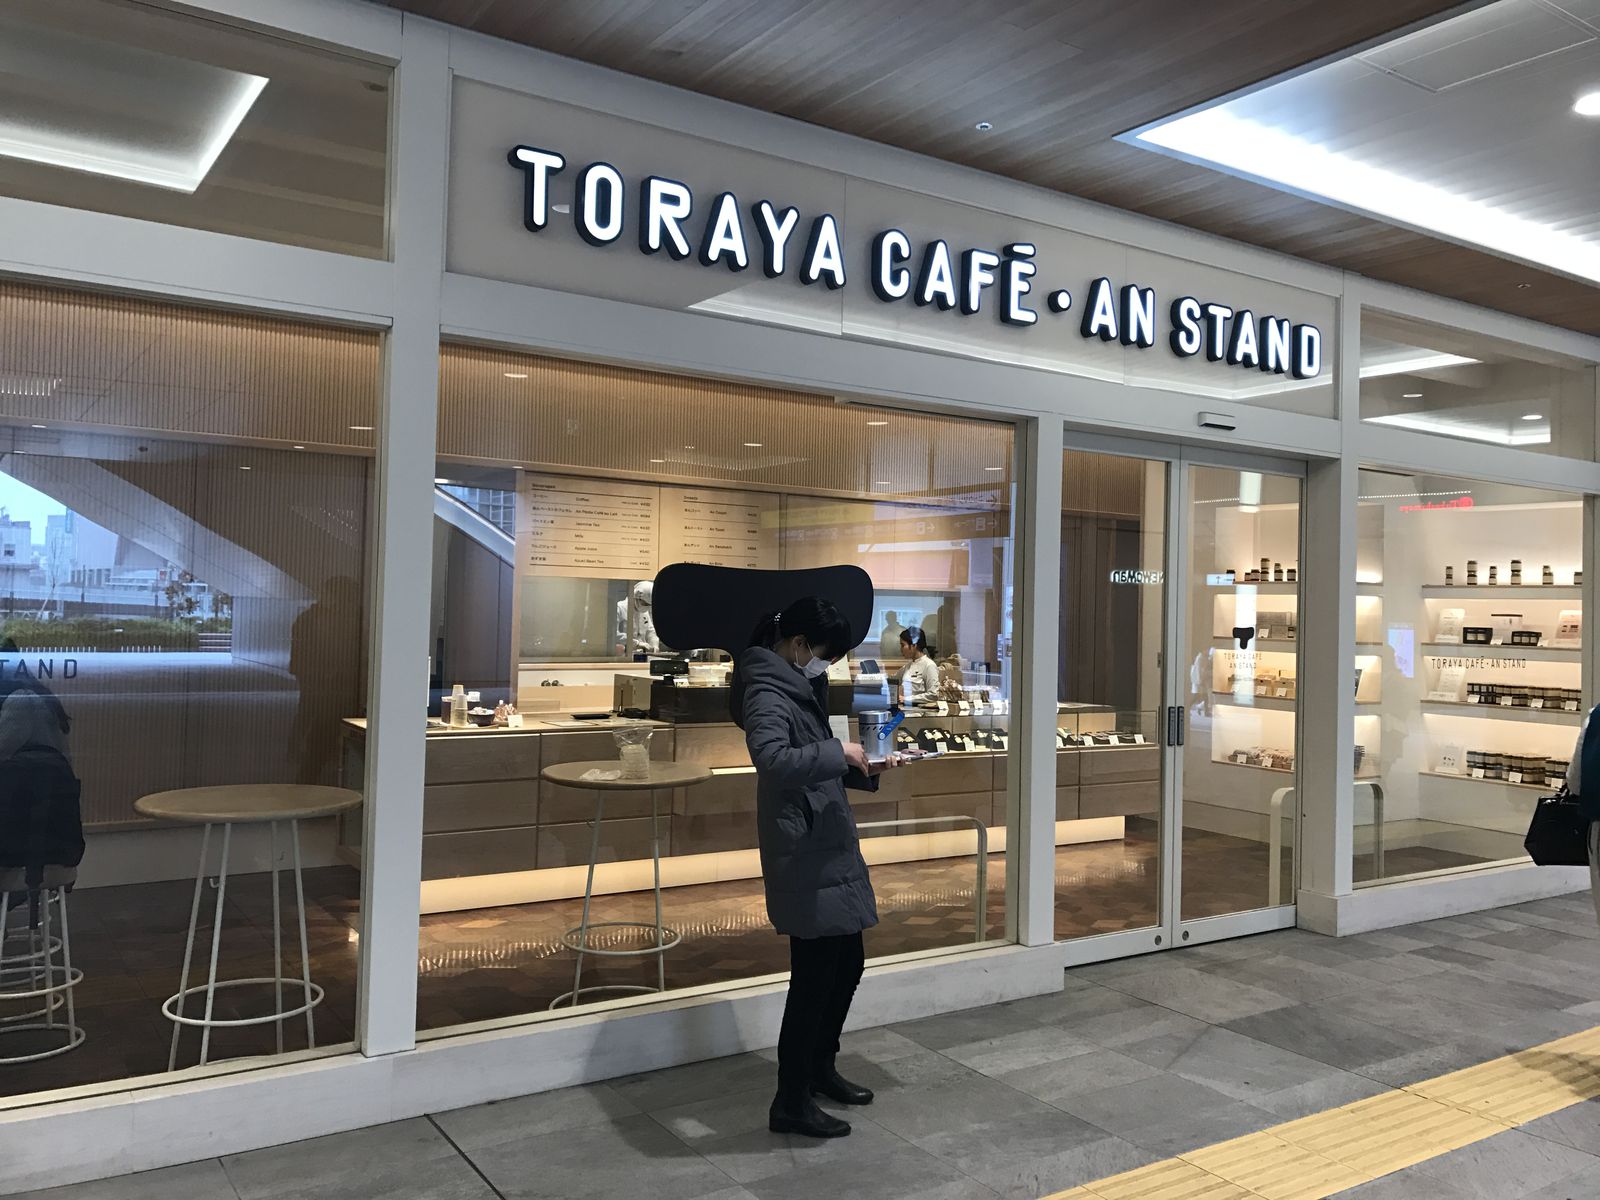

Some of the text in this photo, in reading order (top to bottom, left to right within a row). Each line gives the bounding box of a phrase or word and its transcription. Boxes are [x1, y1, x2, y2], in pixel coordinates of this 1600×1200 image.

[507, 145, 846, 290] TORAYA
[1081, 277, 1155, 348] AN
[1170, 296, 1321, 379] STAND
[1432, 658, 1462, 669] TORAYA
[1491, 658, 1500, 668] AN
[1503, 658, 1526, 669] STAND
